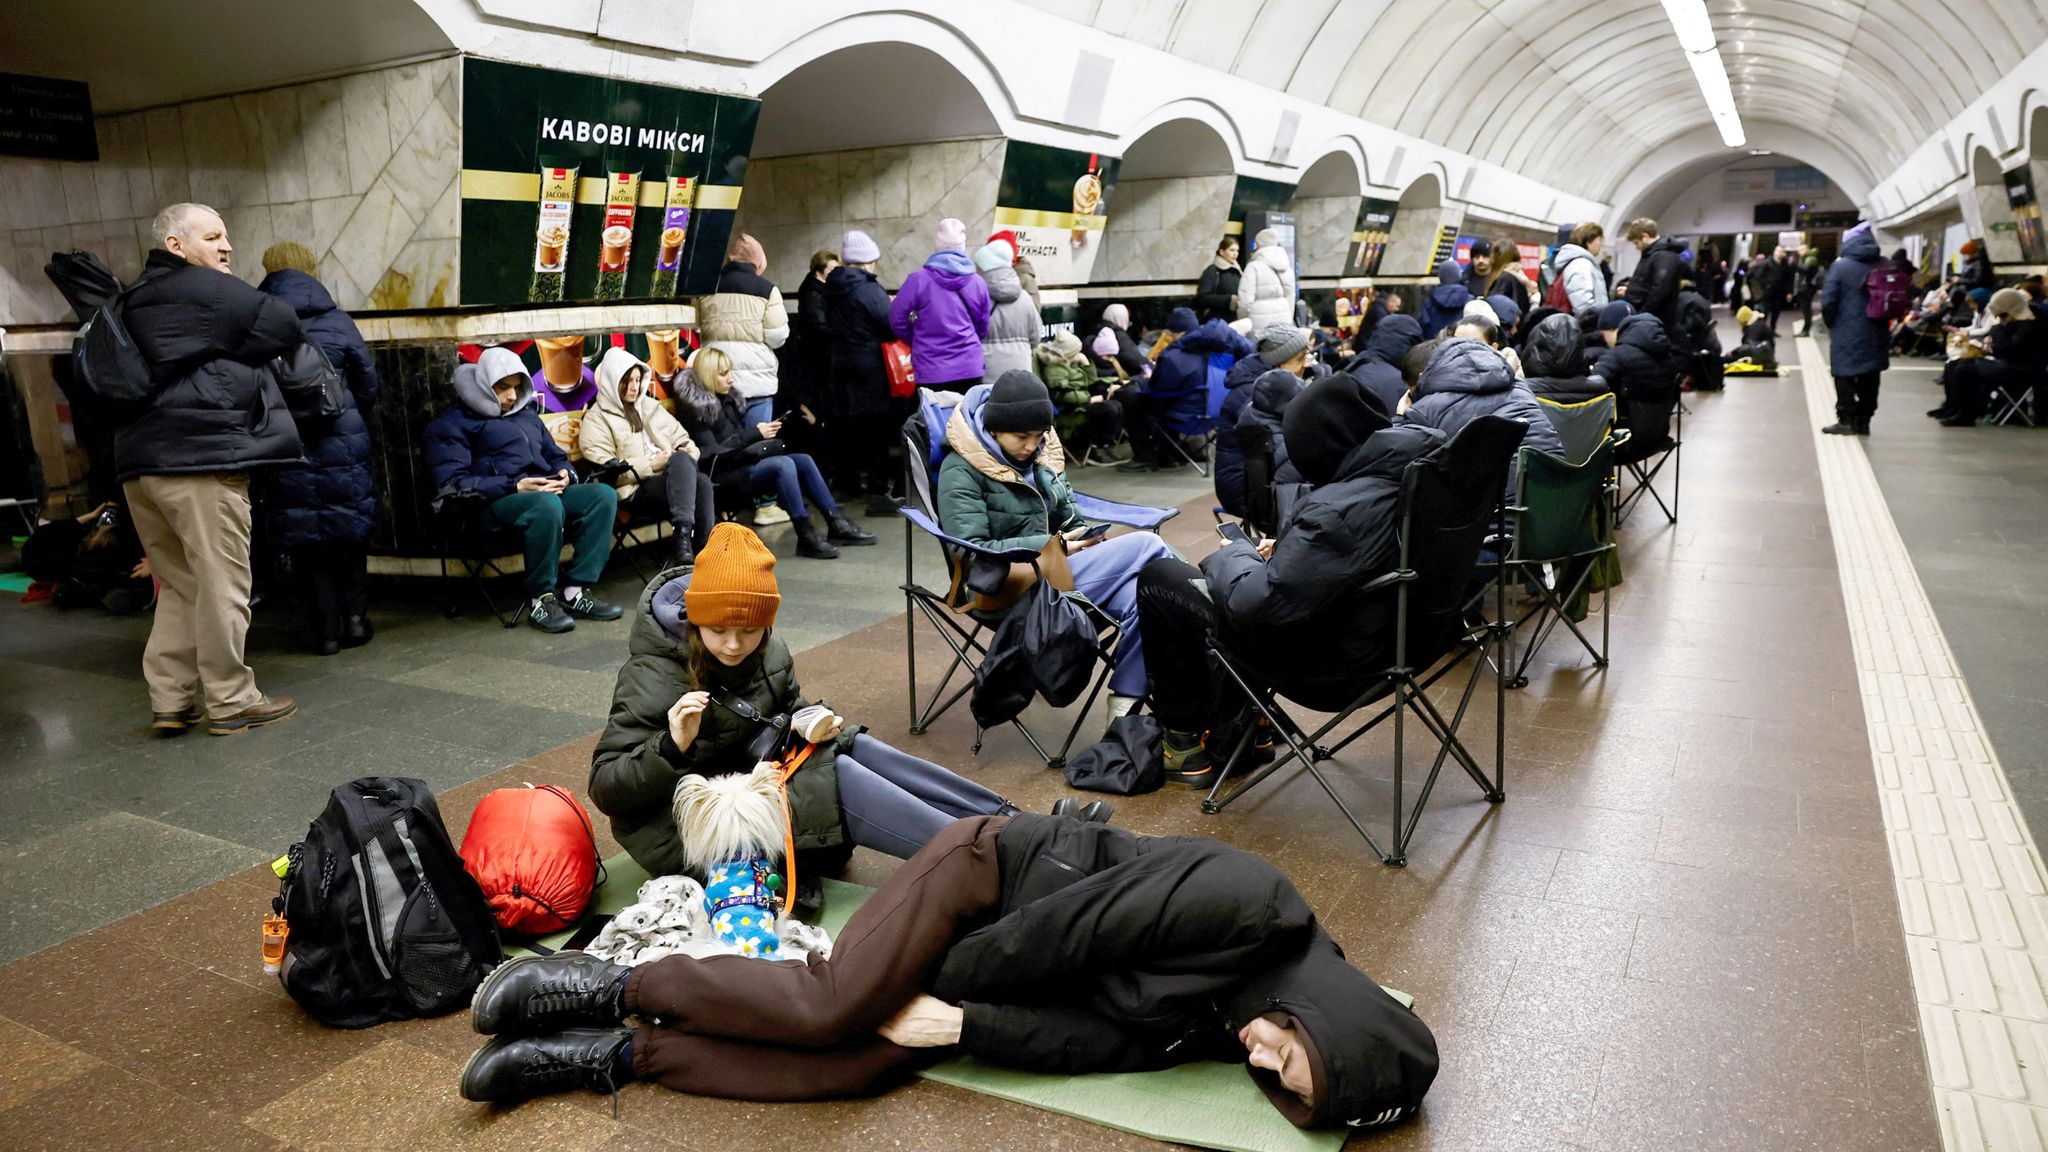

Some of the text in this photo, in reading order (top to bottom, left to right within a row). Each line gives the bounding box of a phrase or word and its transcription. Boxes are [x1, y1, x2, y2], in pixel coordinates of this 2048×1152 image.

[542, 117, 705, 154] КАВОВІ МІКСИ
[545, 191, 570, 199] JACOBS
